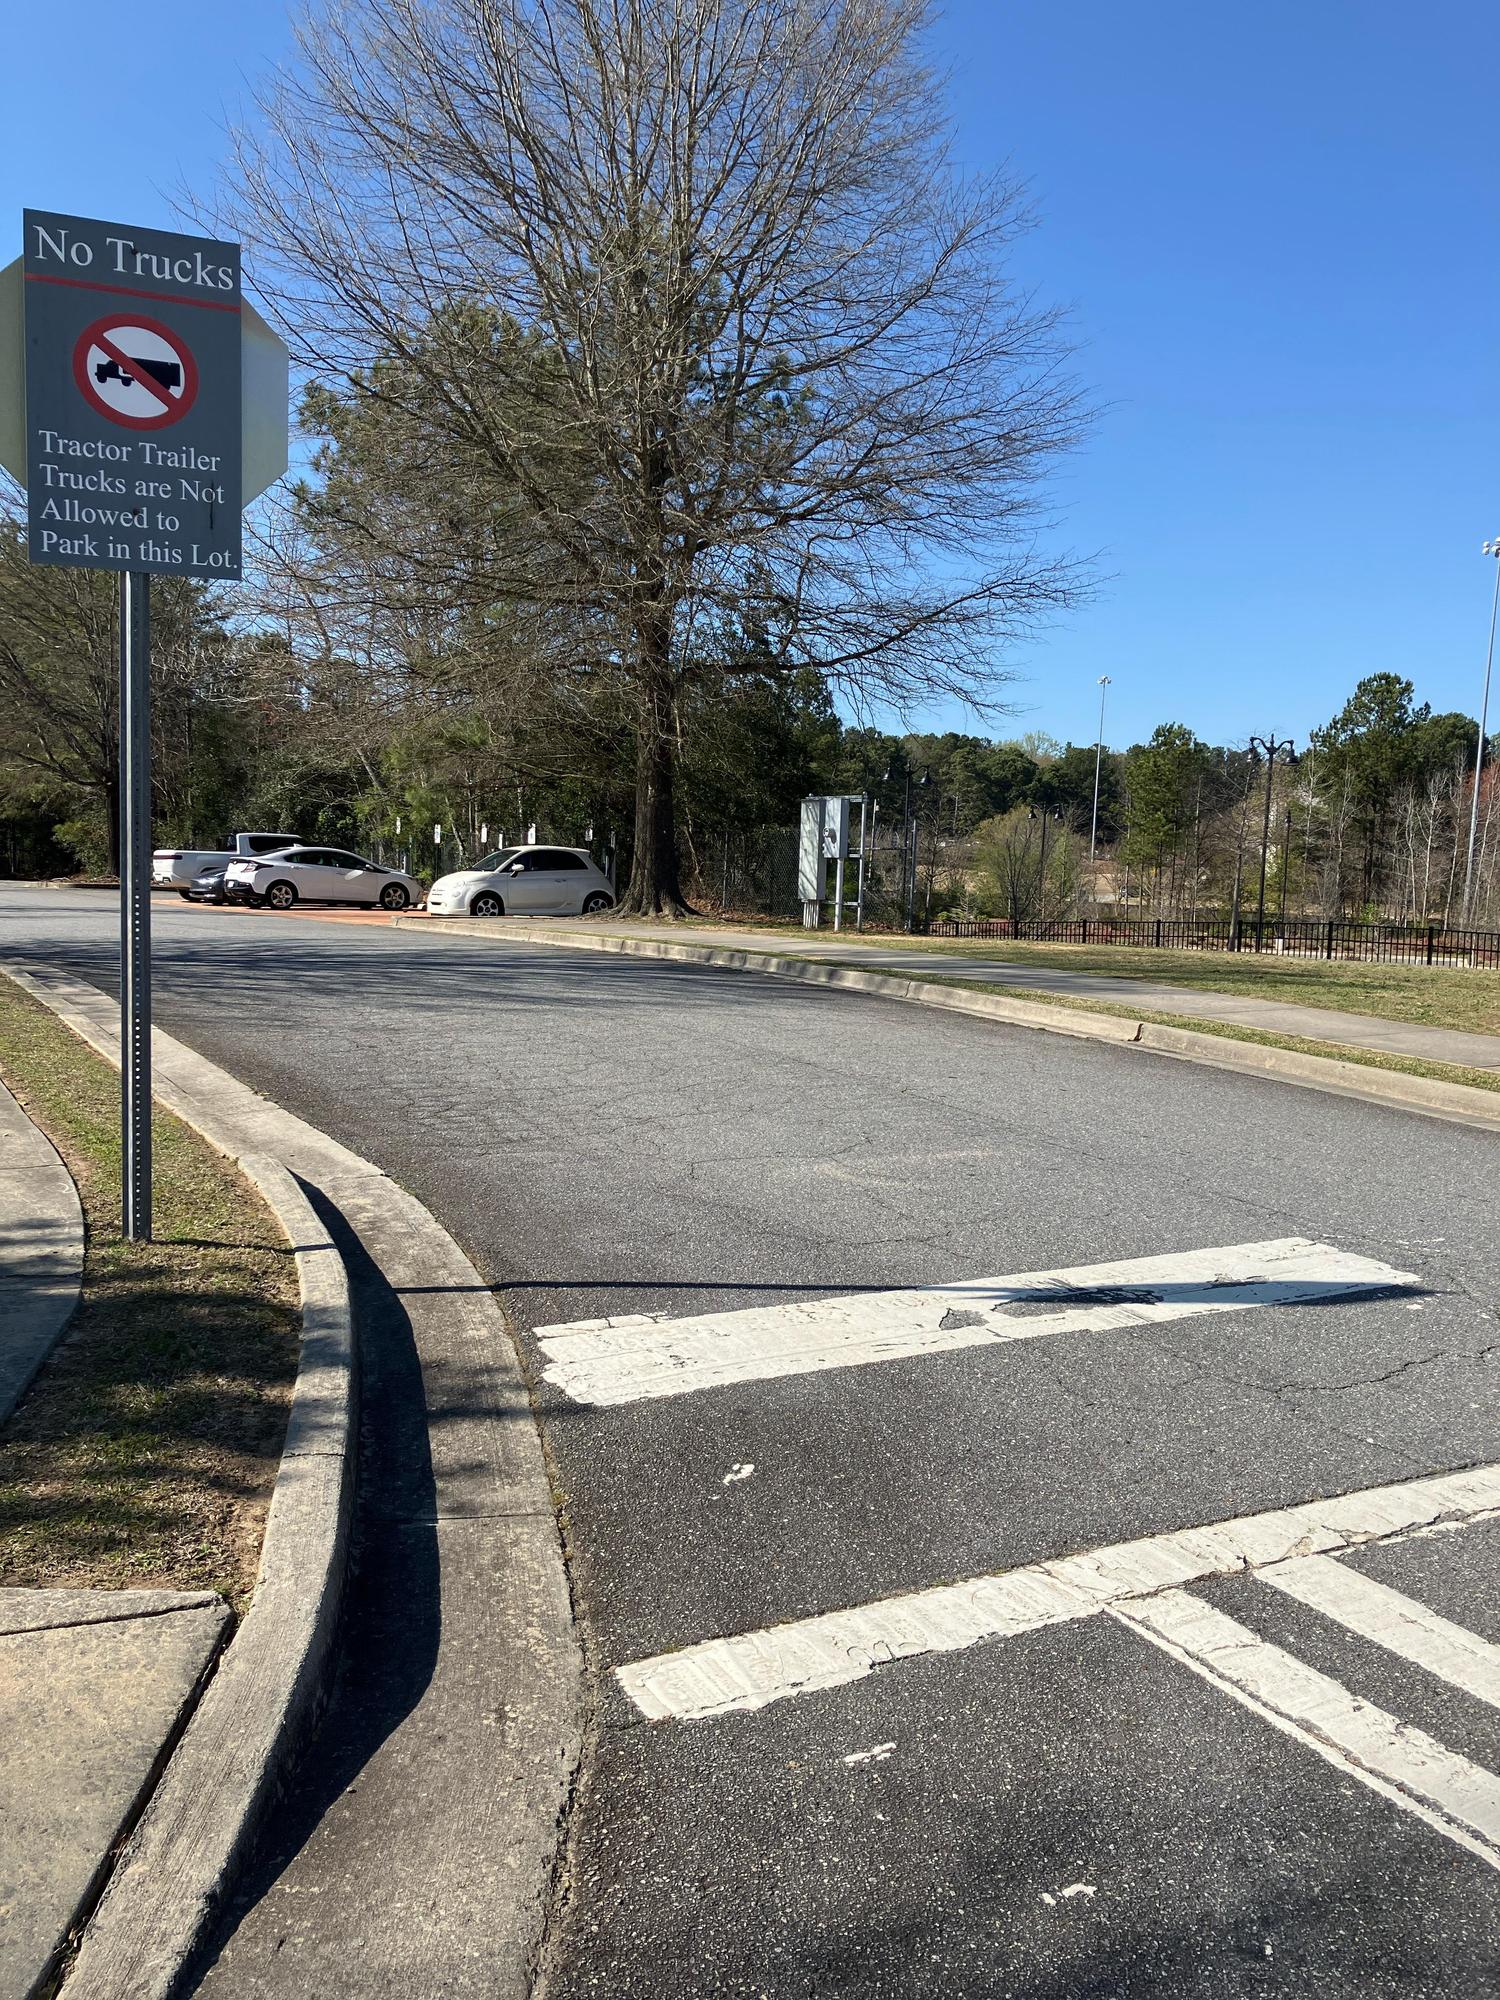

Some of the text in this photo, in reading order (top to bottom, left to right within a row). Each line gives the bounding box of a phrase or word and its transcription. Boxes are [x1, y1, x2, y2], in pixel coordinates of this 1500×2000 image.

[33, 224, 234, 290] No Trucks
[38, 430, 221, 472] Tractor Trailer
[39, 464, 225, 504] Trucks are Not
[40, 498, 180, 532] Allowed to
[40, 530, 239, 569] Park in this Lot.
